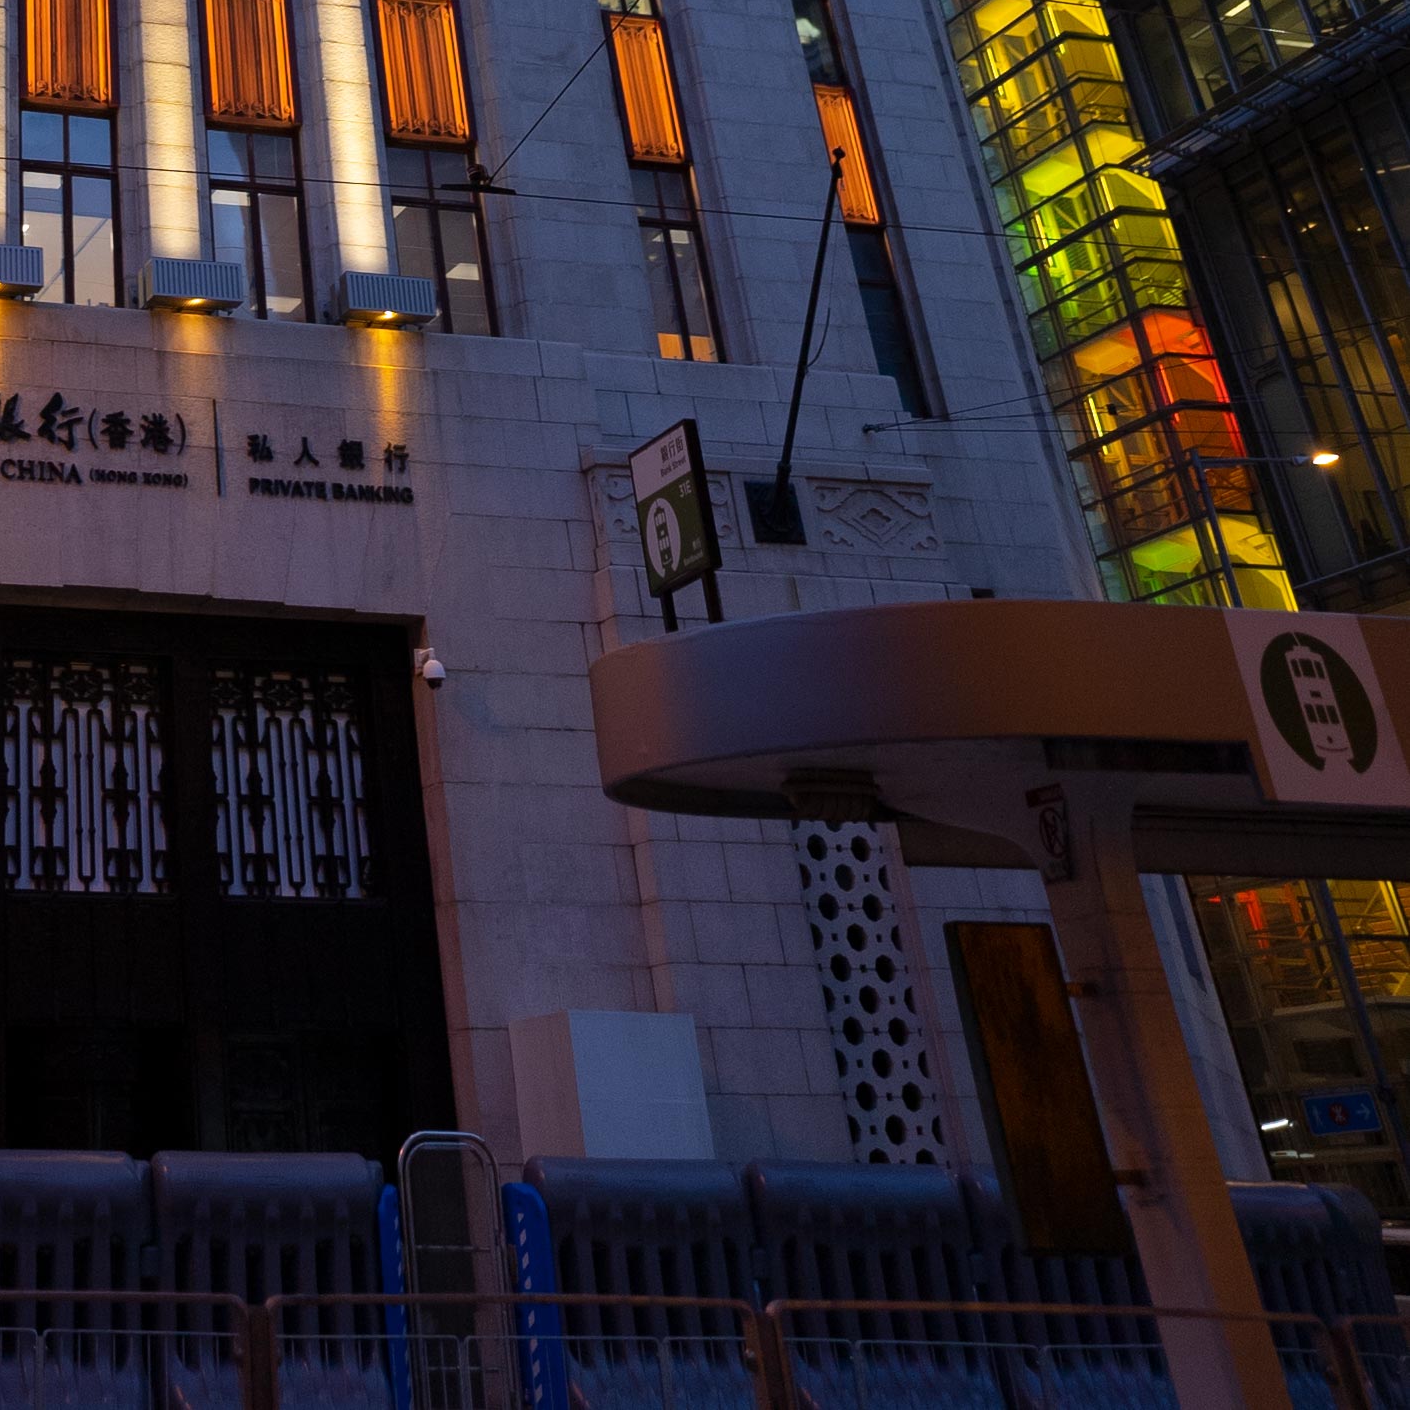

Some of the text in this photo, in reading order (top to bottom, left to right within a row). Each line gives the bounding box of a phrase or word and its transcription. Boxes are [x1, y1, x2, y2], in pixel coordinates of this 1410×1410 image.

[247, 434, 410, 473] 私人銀行
[0, 458, 83, 484] CHINA
[249, 478, 415, 504] PRIVATE BANKING
